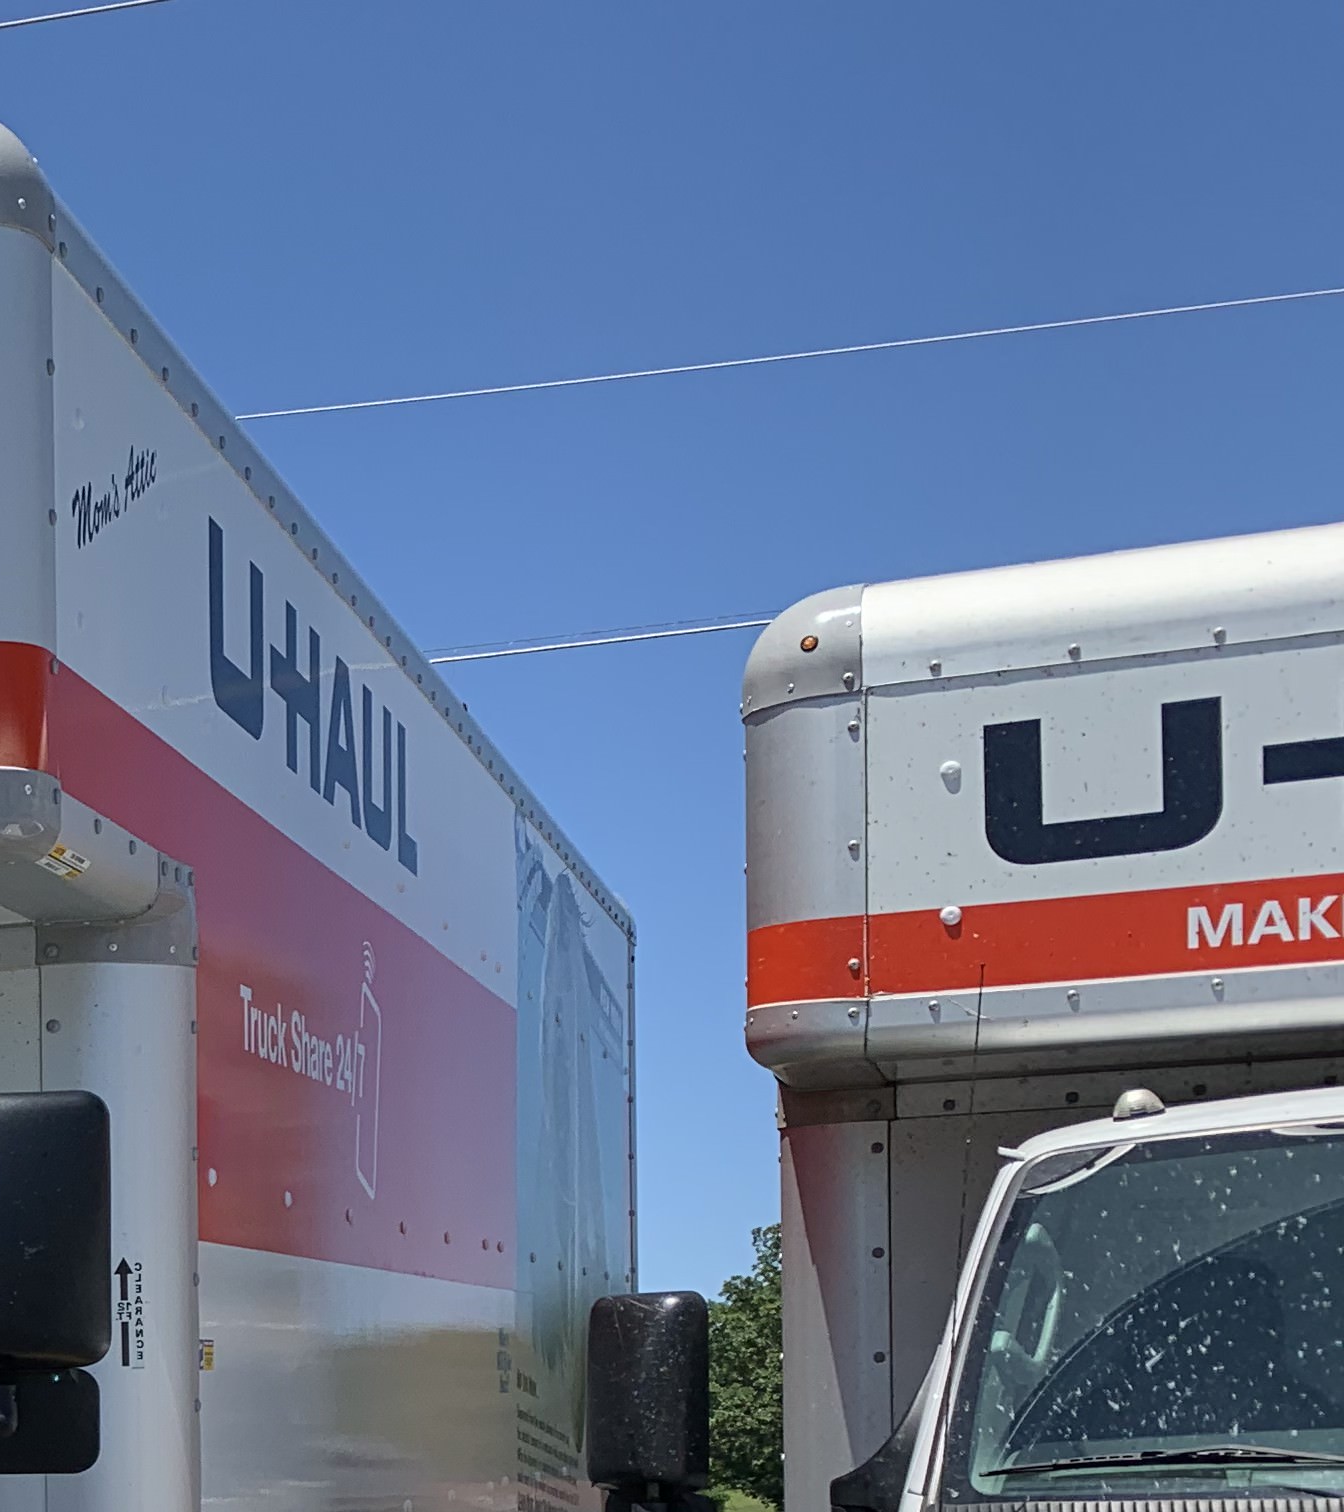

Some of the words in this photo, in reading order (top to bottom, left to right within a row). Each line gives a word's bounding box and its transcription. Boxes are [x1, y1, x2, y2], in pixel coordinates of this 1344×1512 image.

[72, 473, 120, 550] Mom's
[124, 444, 158, 513] Attic
[208, 514, 418, 878] U-HAUL
[1187, 894, 1344, 950] MAK
[239, 983, 288, 1068] Truck
[291, 1009, 333, 1087] Share
[336, 1030, 366, 1107] 24/7
